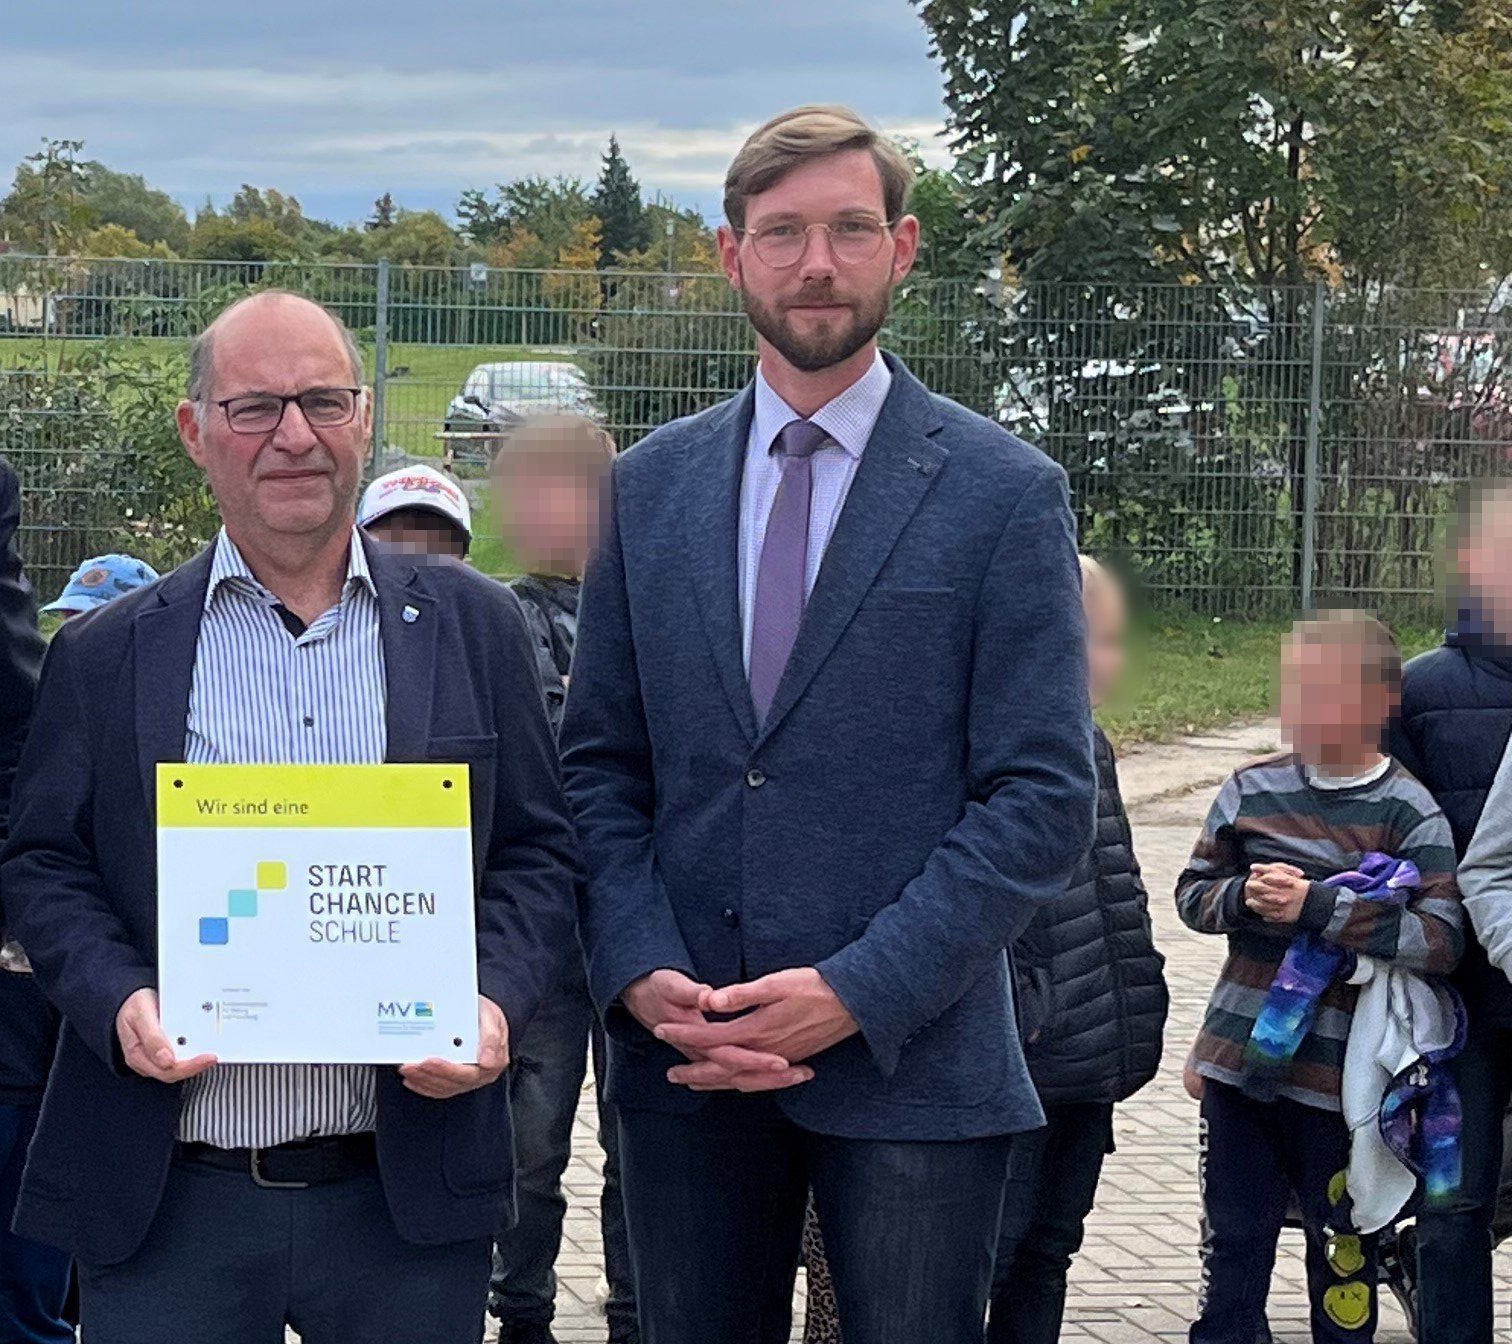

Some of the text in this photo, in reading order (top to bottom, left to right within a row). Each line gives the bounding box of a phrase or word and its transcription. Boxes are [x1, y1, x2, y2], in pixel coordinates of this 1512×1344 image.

[196, 799, 309, 815] Wir sind eine
[308, 864, 387, 887] START
[309, 892, 436, 915] CHANCEN
[309, 920, 401, 943] SCHULE
[377, 1002, 412, 1017] MV
